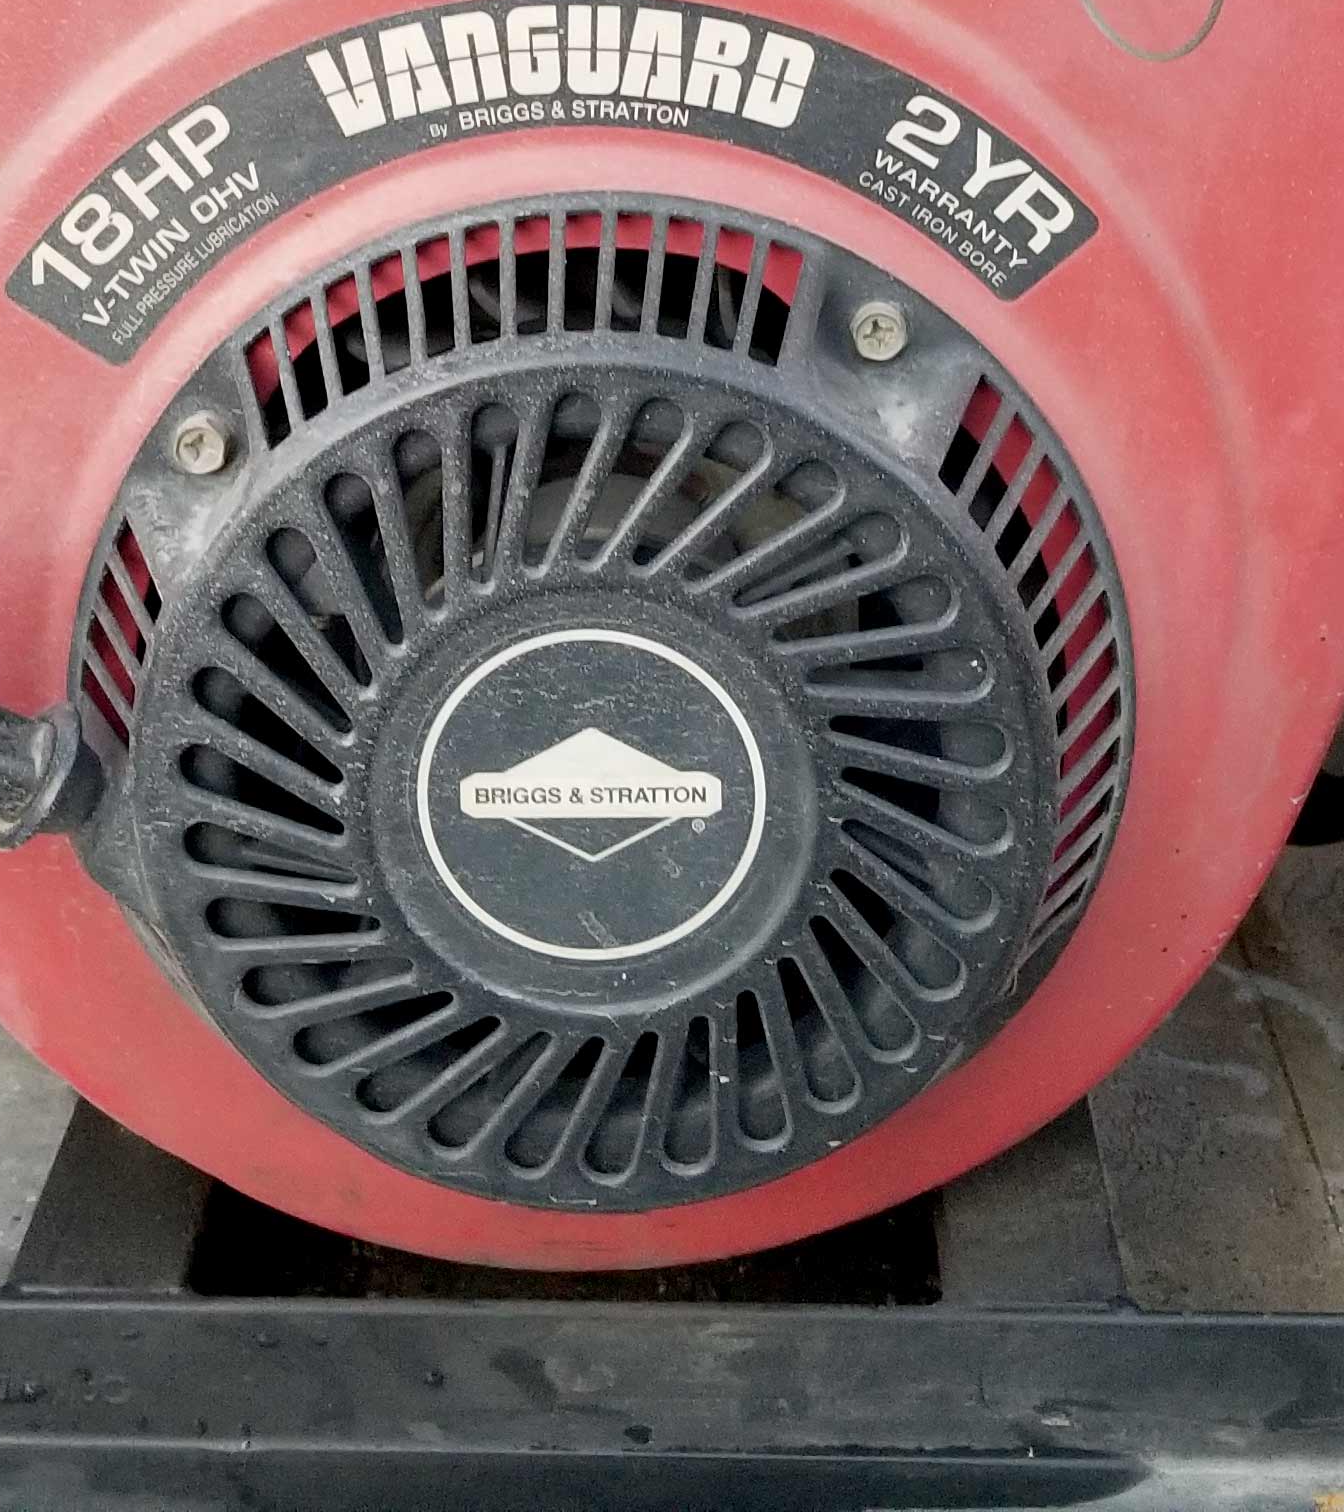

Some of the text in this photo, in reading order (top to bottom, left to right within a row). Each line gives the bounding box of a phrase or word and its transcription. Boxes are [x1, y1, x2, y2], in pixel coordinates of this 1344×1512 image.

[305, 4, 816, 138] VANGUARD
[429, 99, 690, 139] By BRIGGS & STRATTON
[31, 104, 231, 291] 18HP
[81, 160, 261, 328] V-TWIN OHV
[859, 170, 1008, 288] CAST IRON BORE
[874, 148, 1029, 270] WARRANTY
[112, 191, 281, 346] FULL PRESSURE LUBRICATION
[474, 786, 707, 805] BRIGGS & STRATTON
